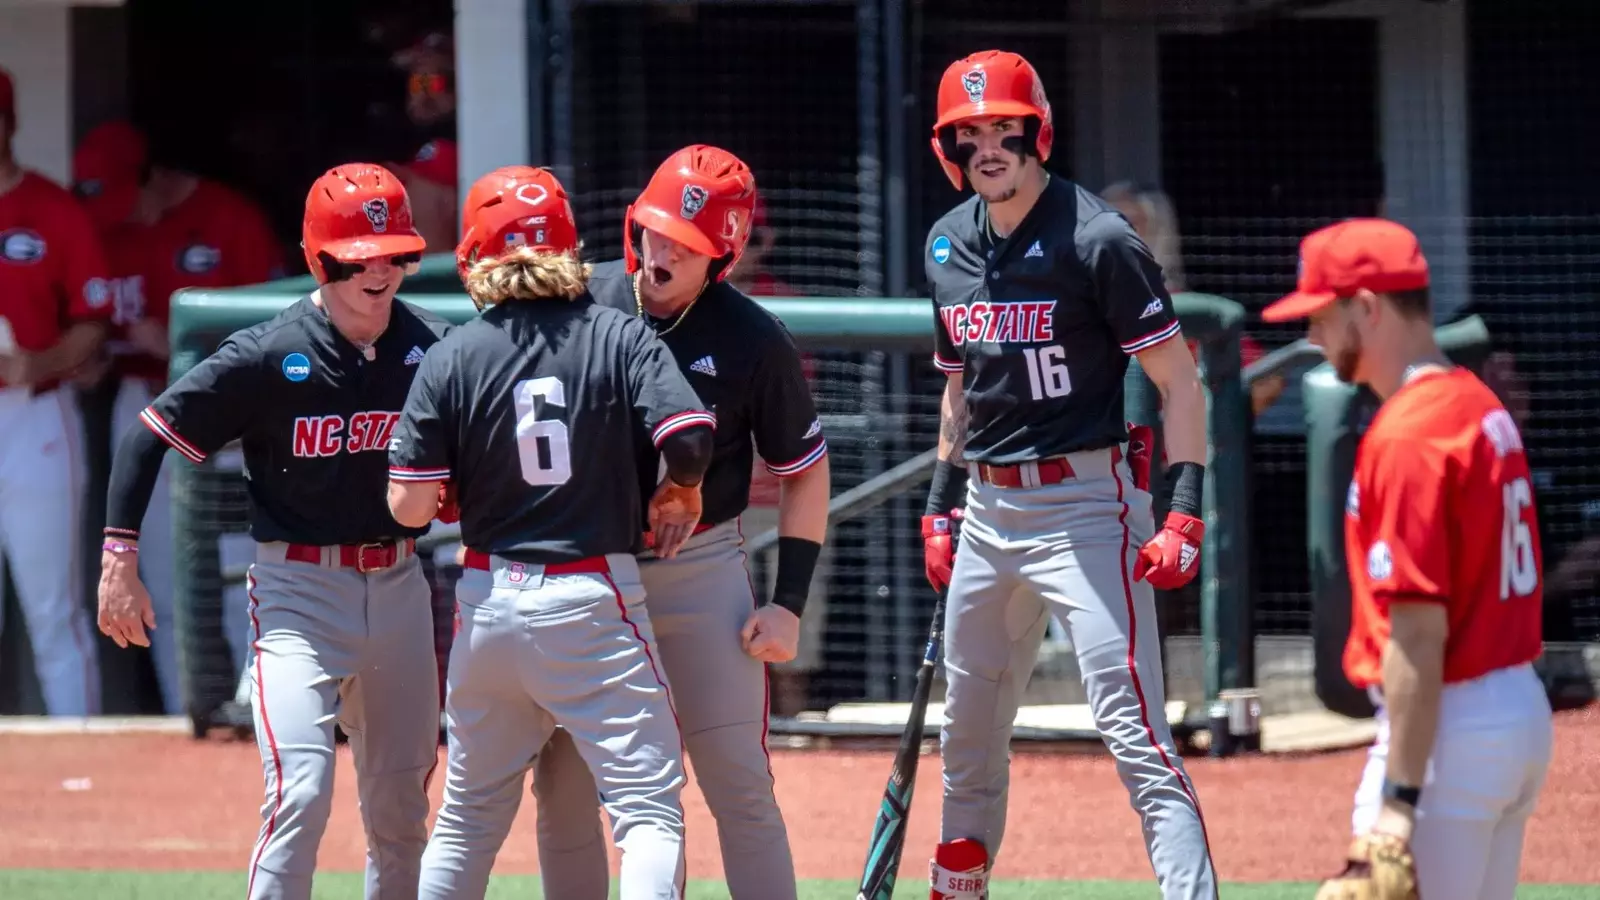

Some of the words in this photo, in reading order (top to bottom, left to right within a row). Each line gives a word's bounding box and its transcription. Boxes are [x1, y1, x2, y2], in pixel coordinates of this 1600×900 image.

[536, 229, 544, 243] 6
[966, 299, 1057, 343] STATE
[286, 366, 309, 375] NCAA
[690, 363, 717, 377] adidas
[1022, 344, 1072, 401] 16
[293, 415, 344, 457] NC
[347, 411, 402, 453] STA
[513, 376, 573, 486] 6
[1500, 477, 1538, 600] 16
[948, 877, 985, 893] SERR
